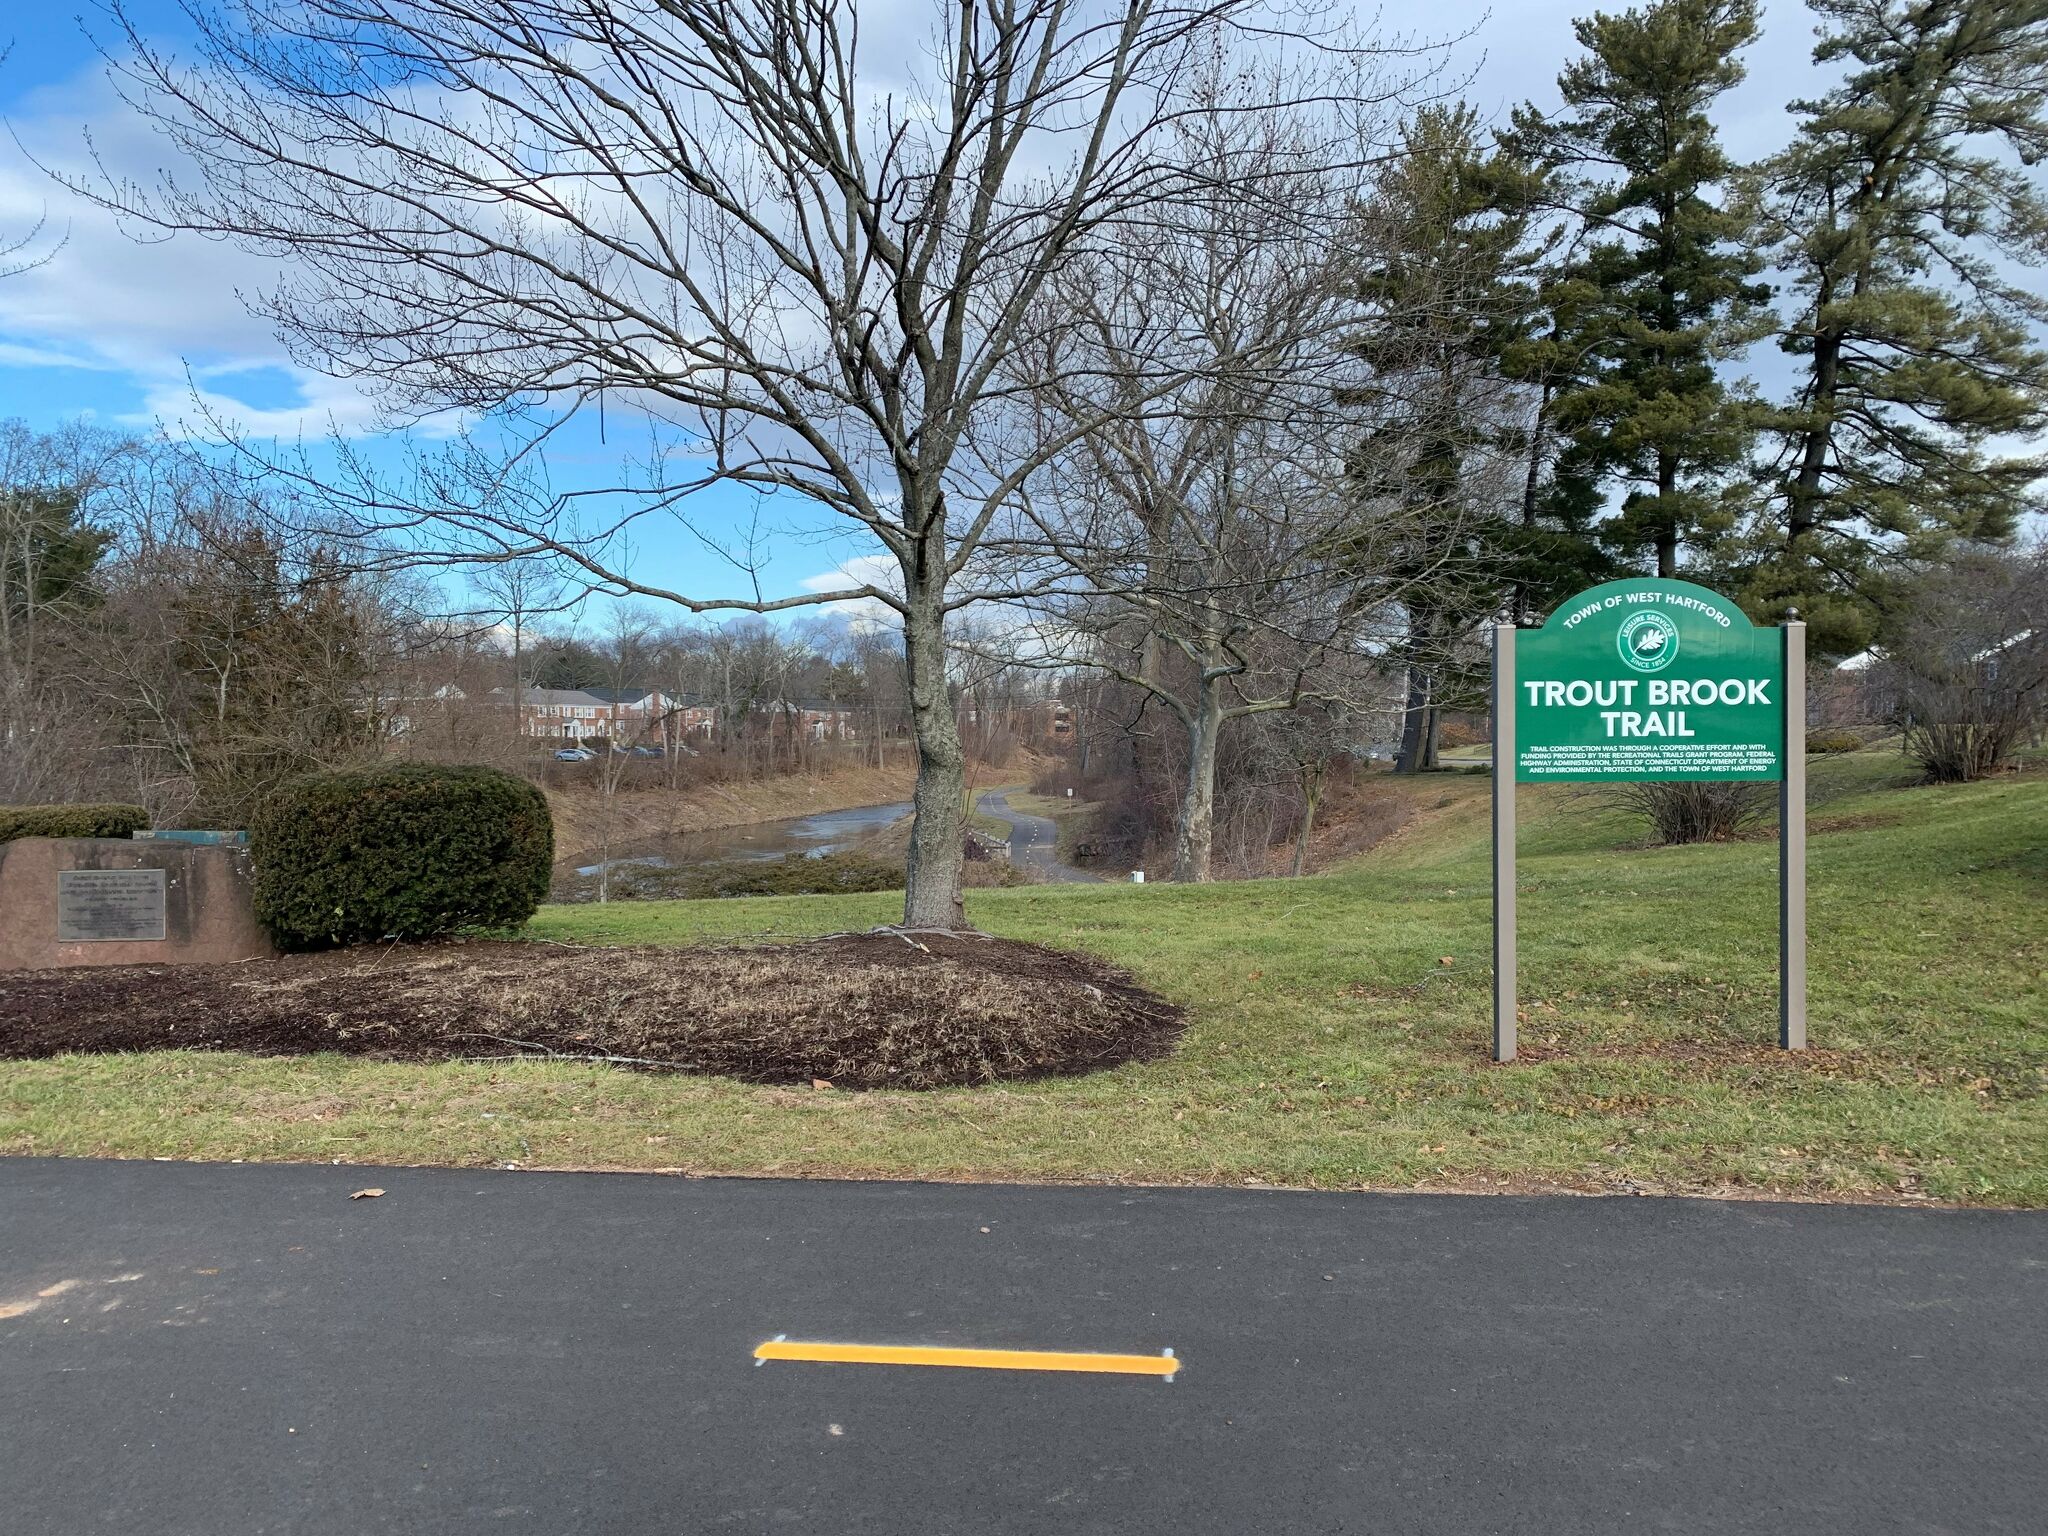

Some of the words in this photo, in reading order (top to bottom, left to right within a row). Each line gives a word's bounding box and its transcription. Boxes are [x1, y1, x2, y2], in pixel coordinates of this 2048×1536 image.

[1563, 602, 1602, 629] TOWN
[1605, 595, 1622, 608] OF
[1626, 592, 1662, 604] WEST
[1666, 593, 1731, 628] HARTFORD
[1622, 614, 1645, 637] LEISURE
[1647, 614, 1674, 637] SERVICES
[1630, 657, 1650, 668] SINCE
[1524, 680, 1638, 707] TROUT
[1649, 679, 1772, 706] BROOK
[1600, 712, 1694, 737] TRAIL
